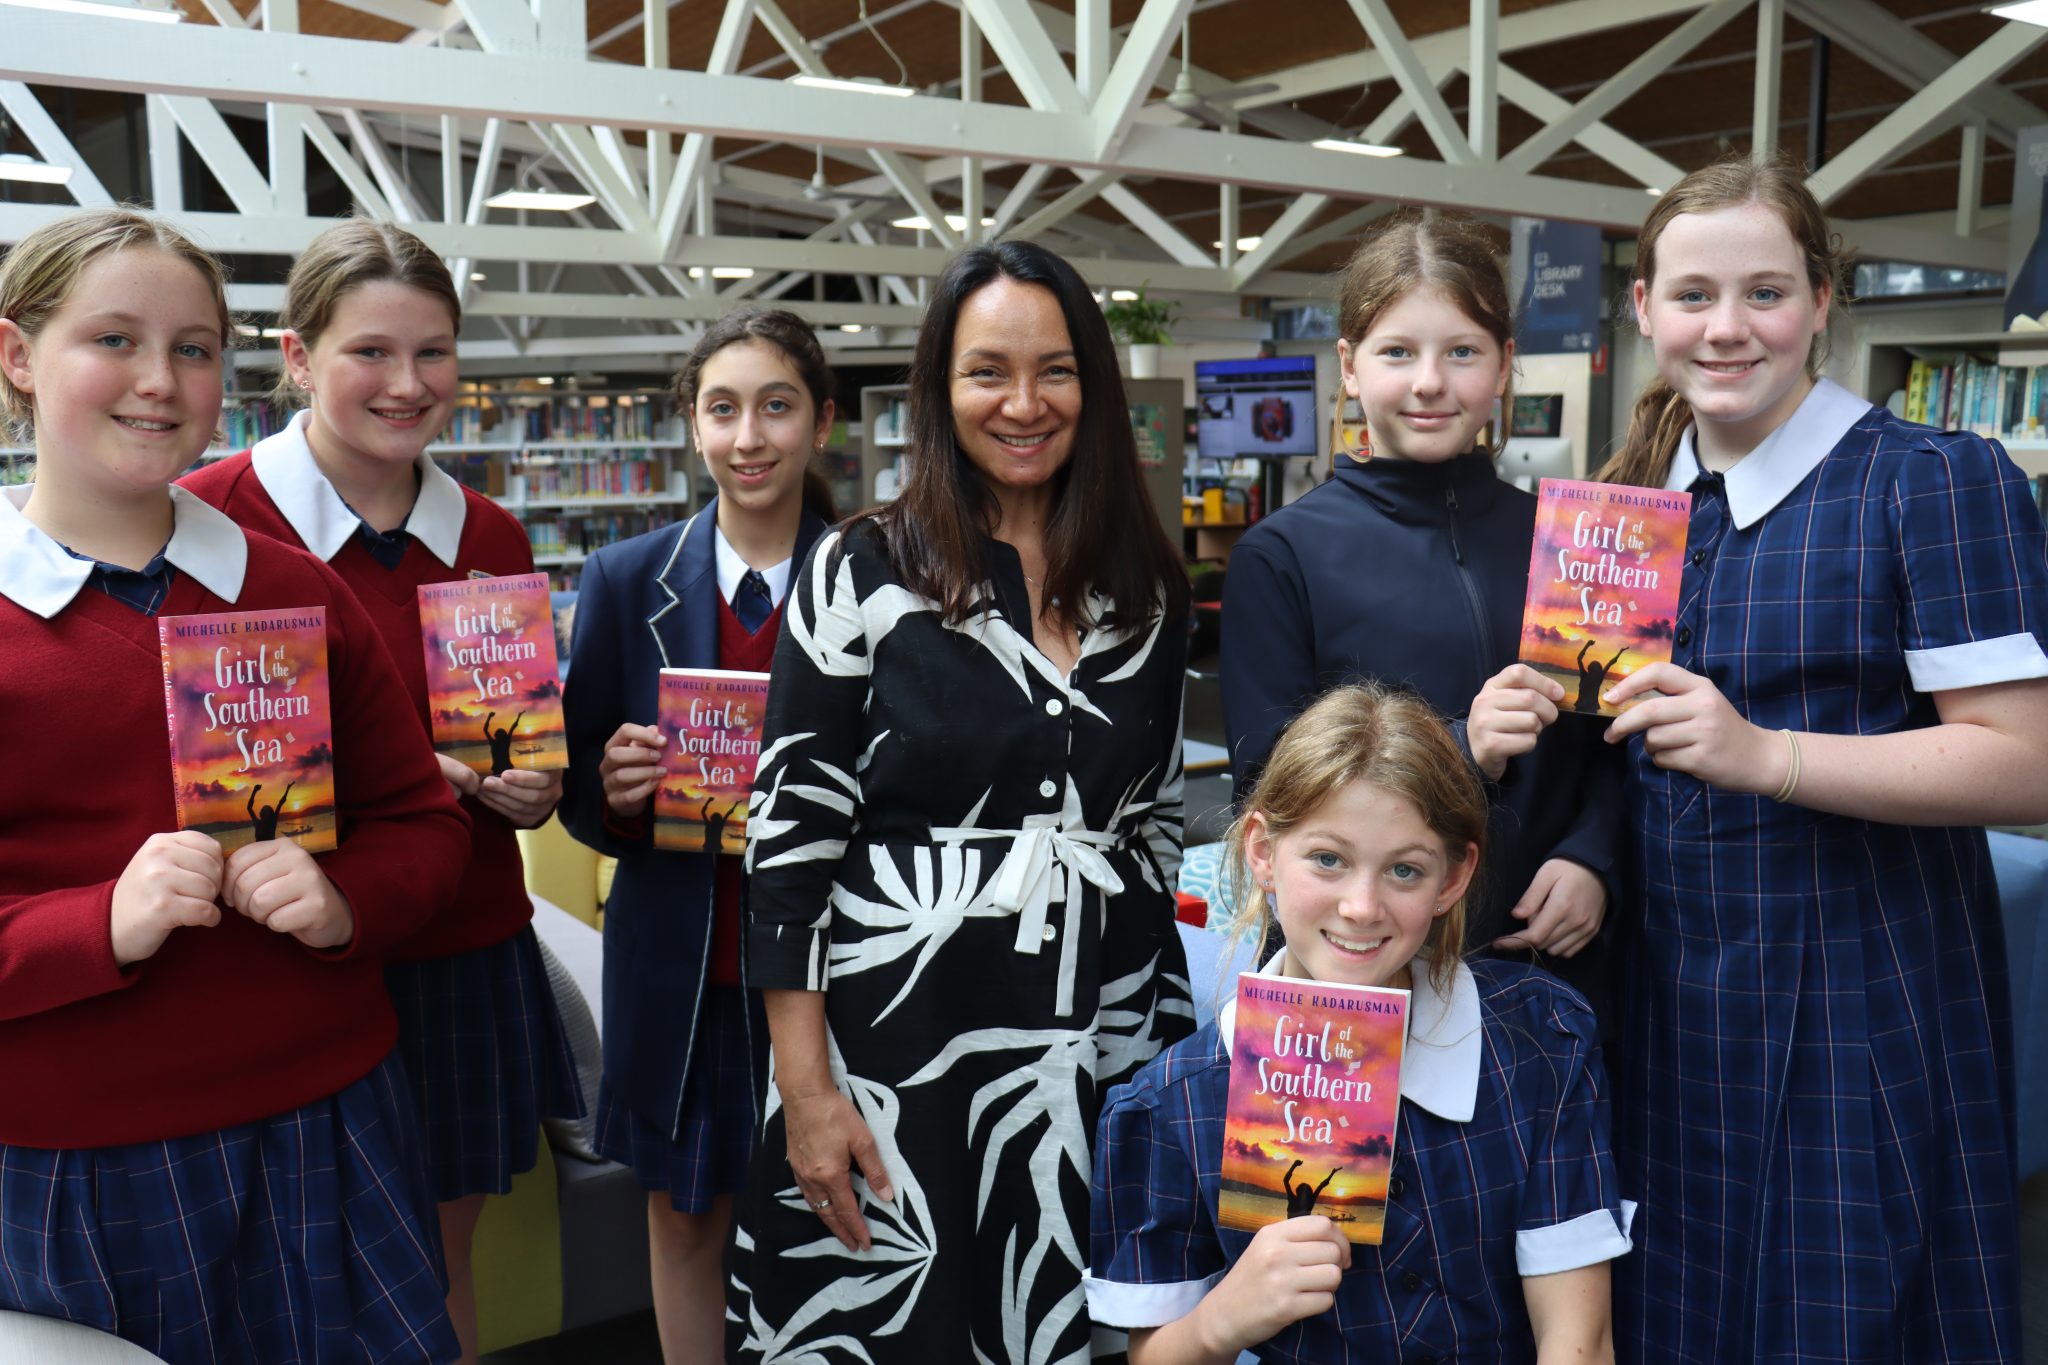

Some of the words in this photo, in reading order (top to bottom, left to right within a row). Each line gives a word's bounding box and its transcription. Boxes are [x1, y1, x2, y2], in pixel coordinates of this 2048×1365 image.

[1535, 265, 1583, 281] LIBRARY
[1534, 282, 1566, 298] DESK
[1546, 486, 1601, 502] MICHELLE
[1609, 493, 1687, 512] KADARUSMAN
[1573, 511, 1625, 553] Girl
[1632, 520, 1644, 534] of
[1628, 535, 1645, 550] the
[1554, 549, 1659, 590] Southern
[425, 587, 472, 600] MICHELLE
[478, 580, 544, 594] KADARUSMAN
[455, 602, 500, 638] Girl
[503, 603, 512, 615] of
[1576, 587, 1623, 627] Sea
[176, 622, 237, 638] MICHELLE
[245, 616, 322, 633] KADARUSMAN
[502, 617, 516, 629] the
[274, 645, 285, 660] of
[446, 636, 537, 672] Southern
[215, 644, 271, 689] Girl
[272, 663, 289, 678] the
[472, 668, 515, 703] Sea
[665, 679, 711, 692] MICHELLE
[203, 687, 310, 733] Southern
[689, 698, 732, 729] Girl
[734, 716, 748, 726] the
[737, 703, 747, 714] of
[236, 728, 286, 773] Sea
[677, 728, 762, 756] Southern
[698, 757, 735, 787] Sea
[1244, 986, 1304, 1005] MICHELLE
[1312, 995, 1400, 1016] KADARUSMAN
[1273, 1015, 1332, 1063] Girl
[1339, 1026, 1353, 1041] of
[1334, 1043, 1354, 1060] the
[1255, 1056, 1372, 1104] Southern
[1280, 1100, 1333, 1145] Sea
